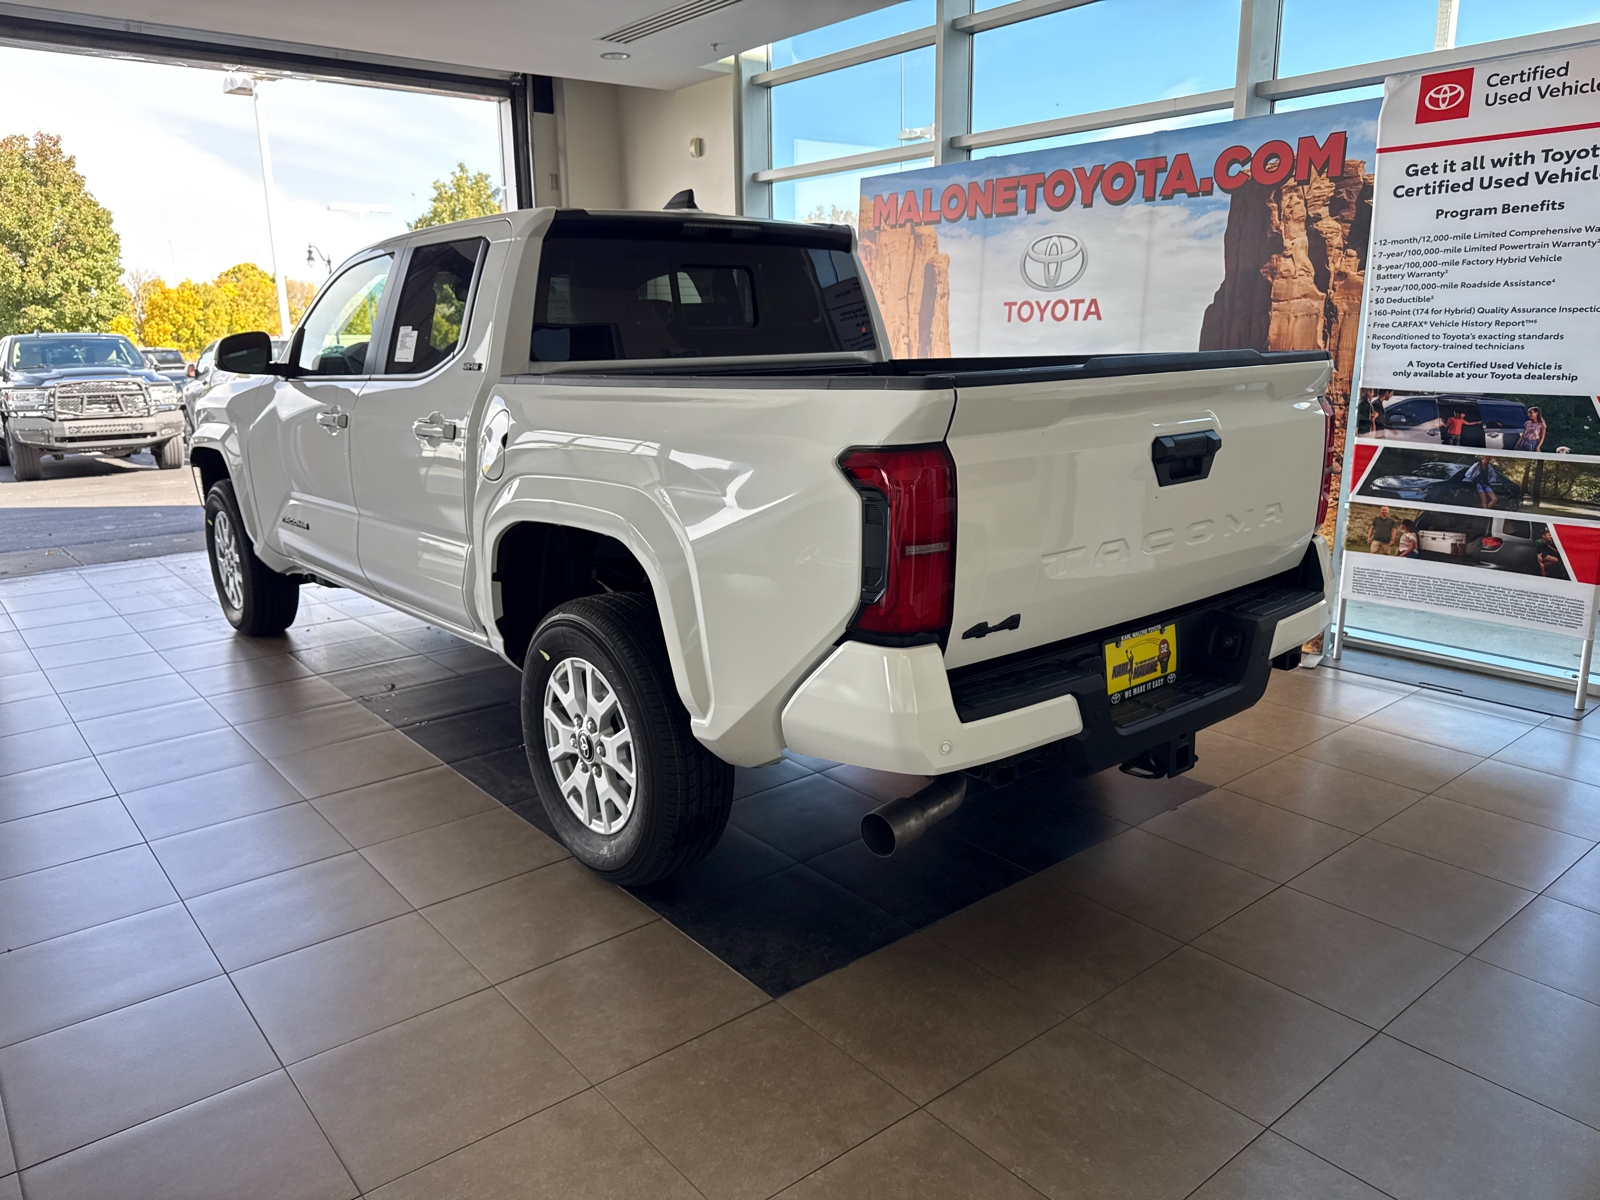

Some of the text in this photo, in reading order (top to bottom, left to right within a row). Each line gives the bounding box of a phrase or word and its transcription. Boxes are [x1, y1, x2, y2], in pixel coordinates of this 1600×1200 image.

[1487, 61, 1570, 87] Certified
[1485, 87, 1531, 106] Used
[1405, 162, 1439, 177] Get
[1443, 160, 1456, 173] it
[1461, 155, 1485, 172] all
[1491, 151, 1535, 168] with
[873, 131, 1347, 229] MALONETOYOTA.COM
[1393, 165, 1600, 198] Certified Used Vehicl
[1435, 200, 1565, 220] Program Benefits
[1379, 233, 1471, 246] 12-month/12,000-mile
[1473, 230, 1506, 240] Limited
[1509, 226, 1582, 238] Comprehensive
[1378, 246, 1462, 259] 7-year/100,000-mile
[1464, 244, 1497, 252] Limited
[1499, 242, 1549, 251] Powertrain
[1377, 254, 1562, 271] 8-year/100,000-mile Factory Hybrid Vehicle
[1377, 272, 1405, 280] Battery
[1376, 281, 1458, 293] 7-year/100,000-mile
[1461, 280, 1501, 289] Roadside
[1375, 297, 1384, 305] $0
[1003, 298, 1102, 323] TOYOTA
[1413, 308, 1429, 316] (174
[1444, 307, 1475, 316] Hybrid)
[1477, 307, 1509, 317] Quality
[1461, 320, 1492, 328] History
[1372, 333, 1429, 341] Reconditioned
[1442, 333, 1475, 342] Toyota's
[1478, 333, 1515, 342] exacting
[1371, 343, 1381, 351] by
[1383, 343, 1408, 351] Toyota
[1410, 342, 1472, 351] factory-trained
[1416, 361, 1445, 369] Toyota
[1447, 361, 1487, 369] Certified
[1490, 362, 1514, 370] Used
[1392, 371, 1412, 379] only
[1467, 373, 1488, 381] your
[1490, 372, 1521, 380] Toyota
[1524, 372, 1578, 381] dealership
[1041, 502, 1283, 576] TACOMA
[1160, 644, 1168, 653] 32
[1124, 678, 1164, 698] WE MAKE IT EASY
